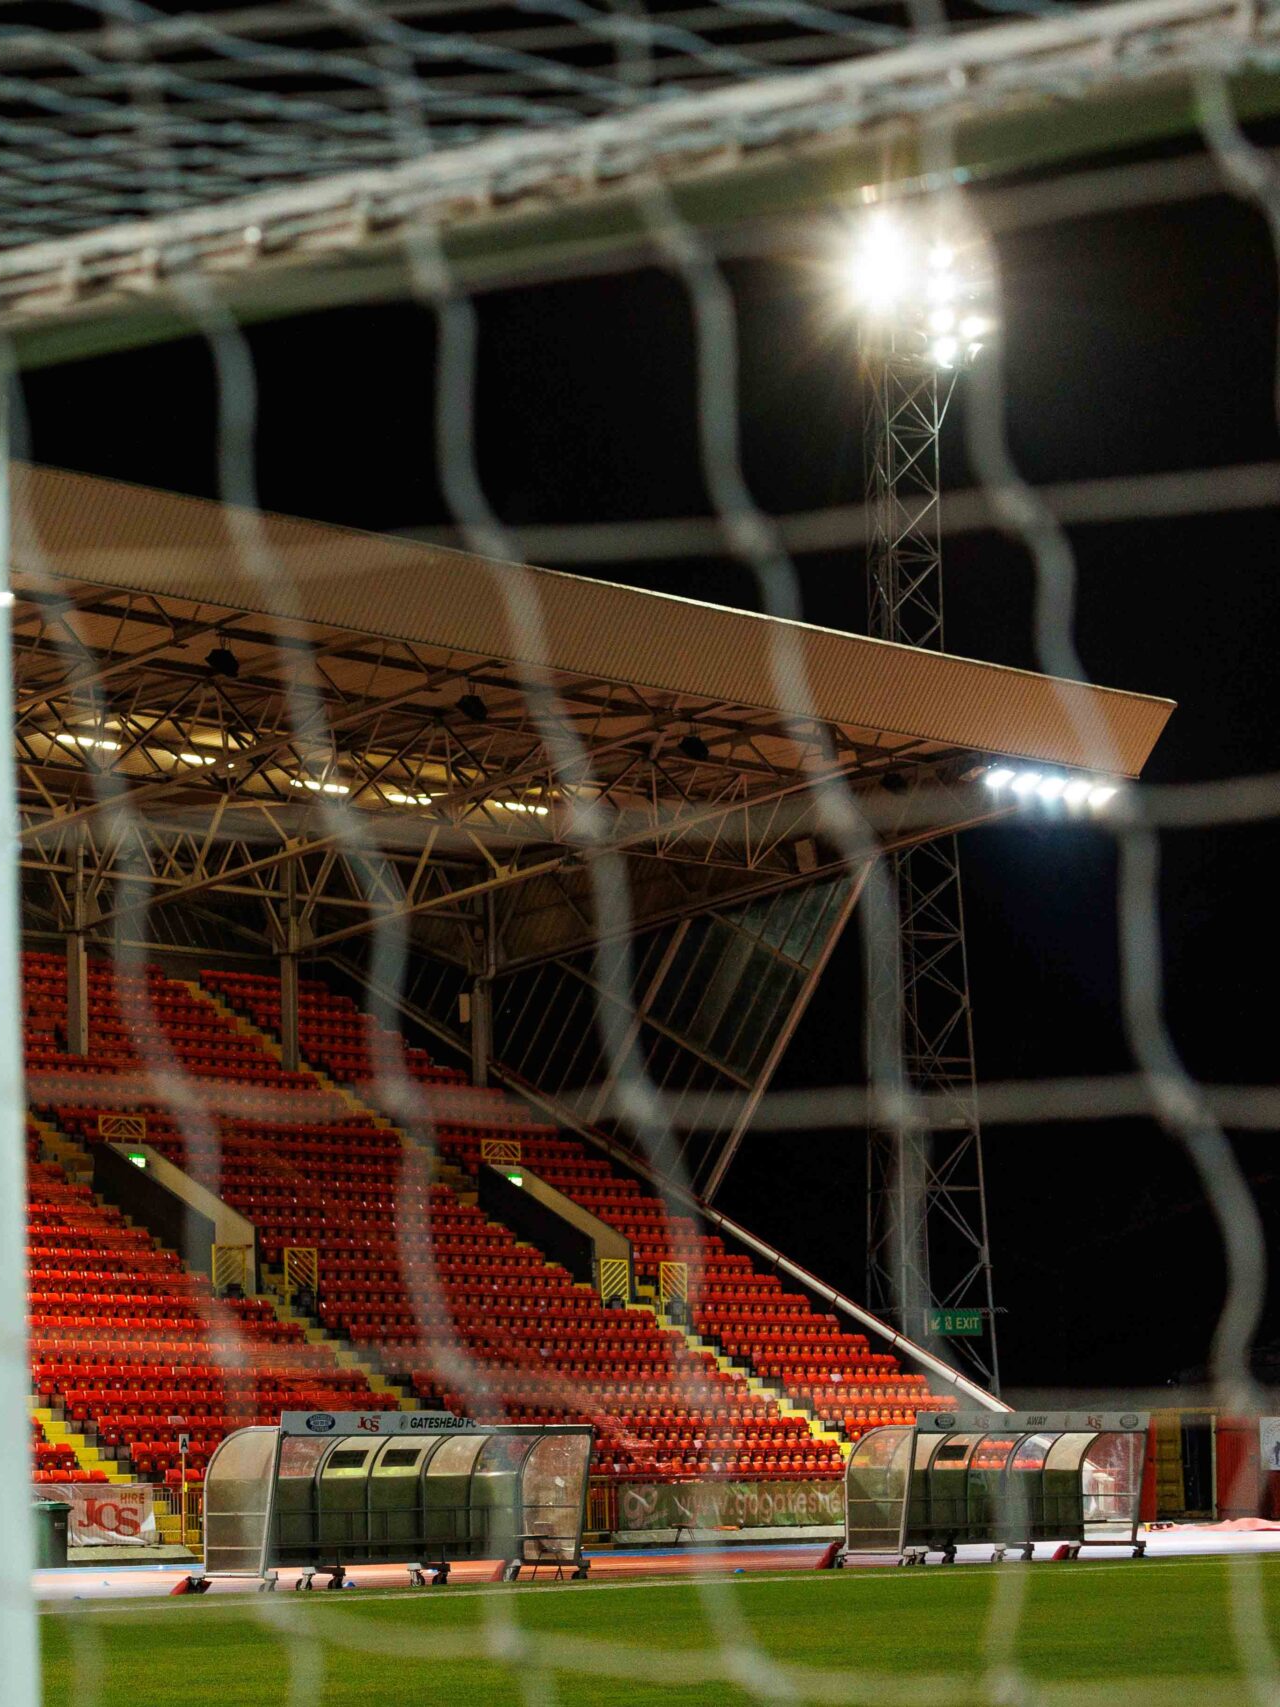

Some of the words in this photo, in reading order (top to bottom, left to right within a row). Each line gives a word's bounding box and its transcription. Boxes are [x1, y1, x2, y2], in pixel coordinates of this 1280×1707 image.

[956, 1317, 979, 1329] EXIT
[410, 1417, 464, 1428] GATESHEAD
[465, 1418, 477, 1428] FC
[1027, 1416, 1048, 1425] AWAY
[181, 1438, 188, 1449] A
[120, 1493, 145, 1504] HIRE
